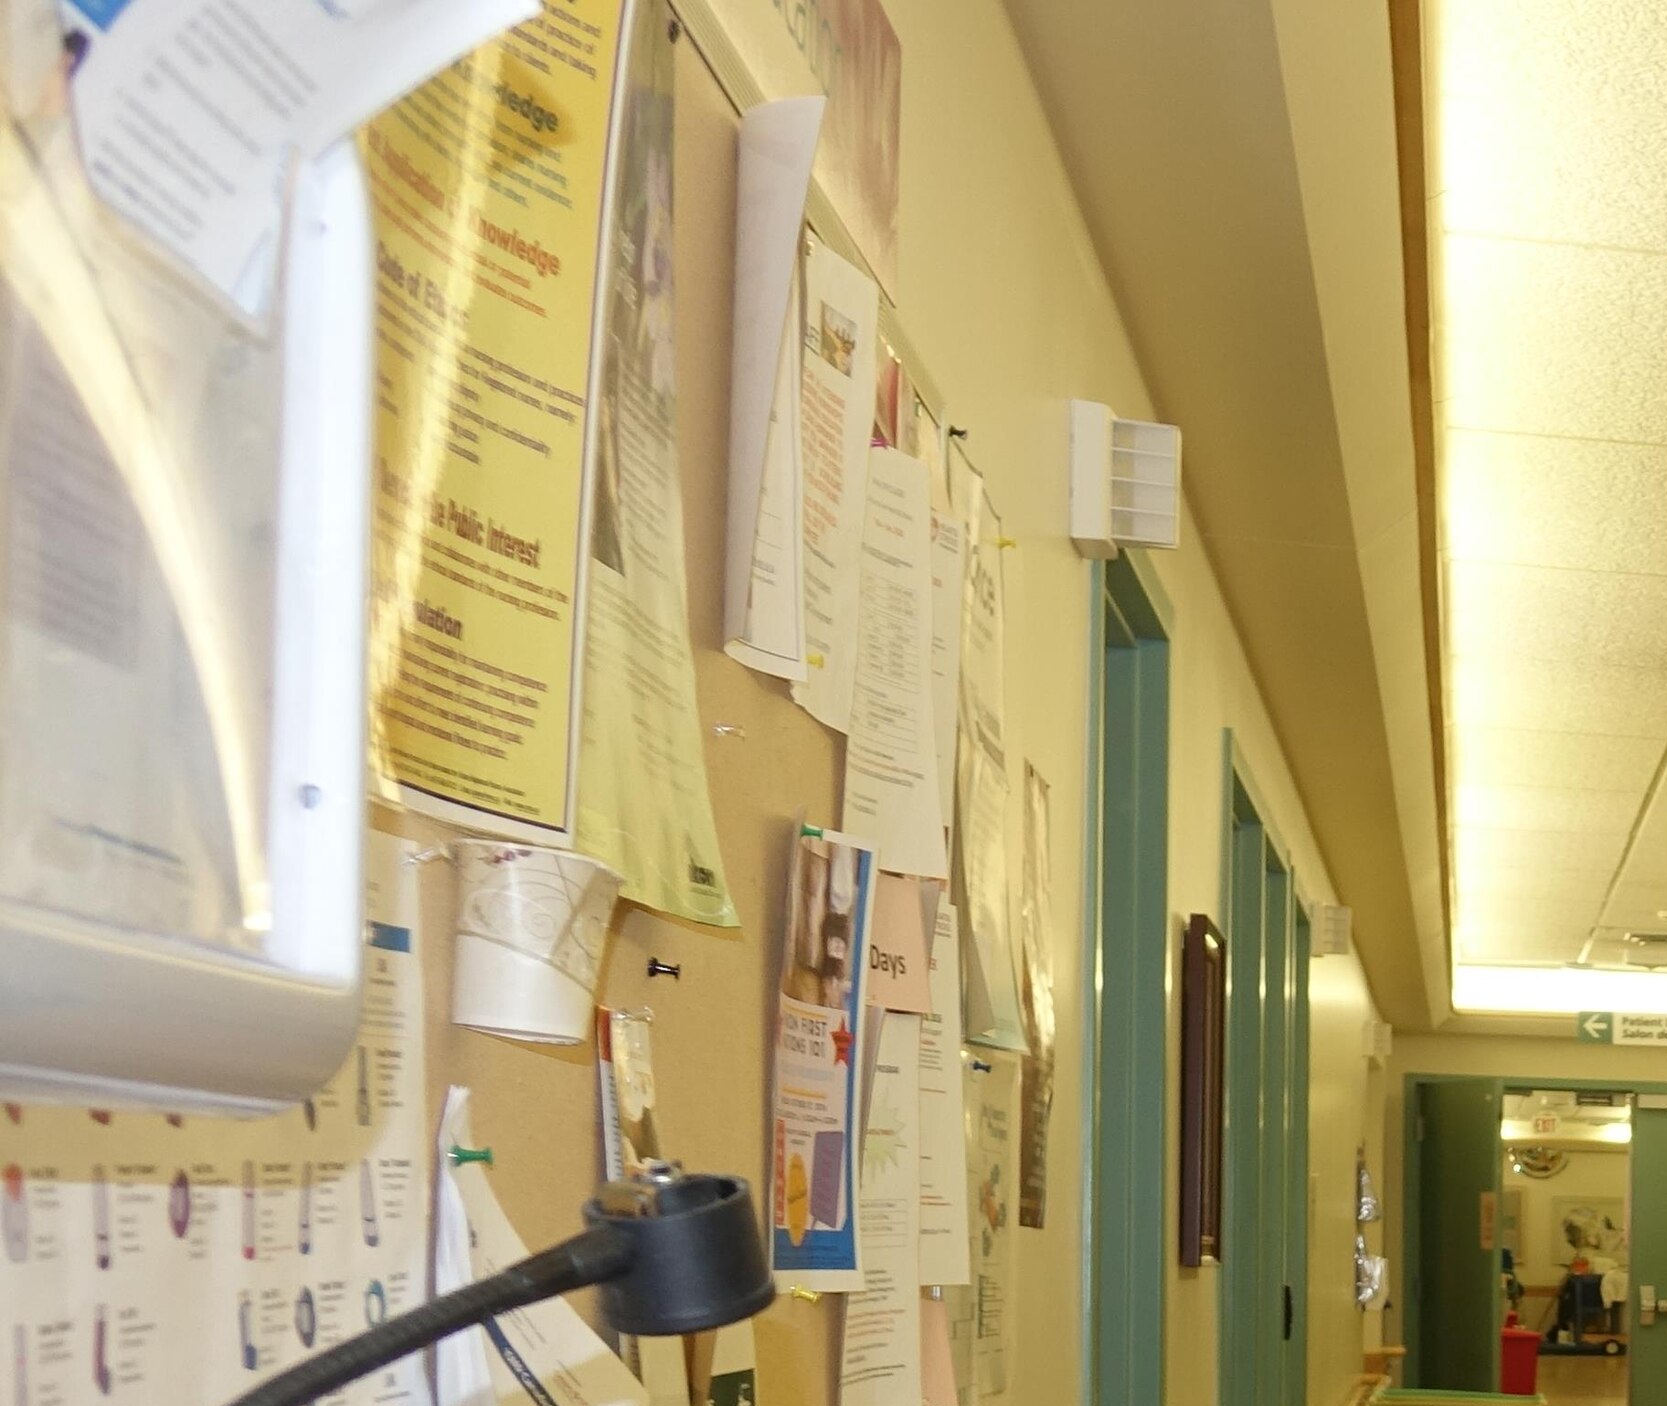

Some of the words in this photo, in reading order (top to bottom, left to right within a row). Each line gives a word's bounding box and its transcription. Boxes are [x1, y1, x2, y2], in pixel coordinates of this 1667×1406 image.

[487, 516, 542, 570] Interest
[870, 945, 906, 979] Days
[1622, 1016, 1663, 1028] Patient
[1622, 1029, 1655, 1039] Salon
